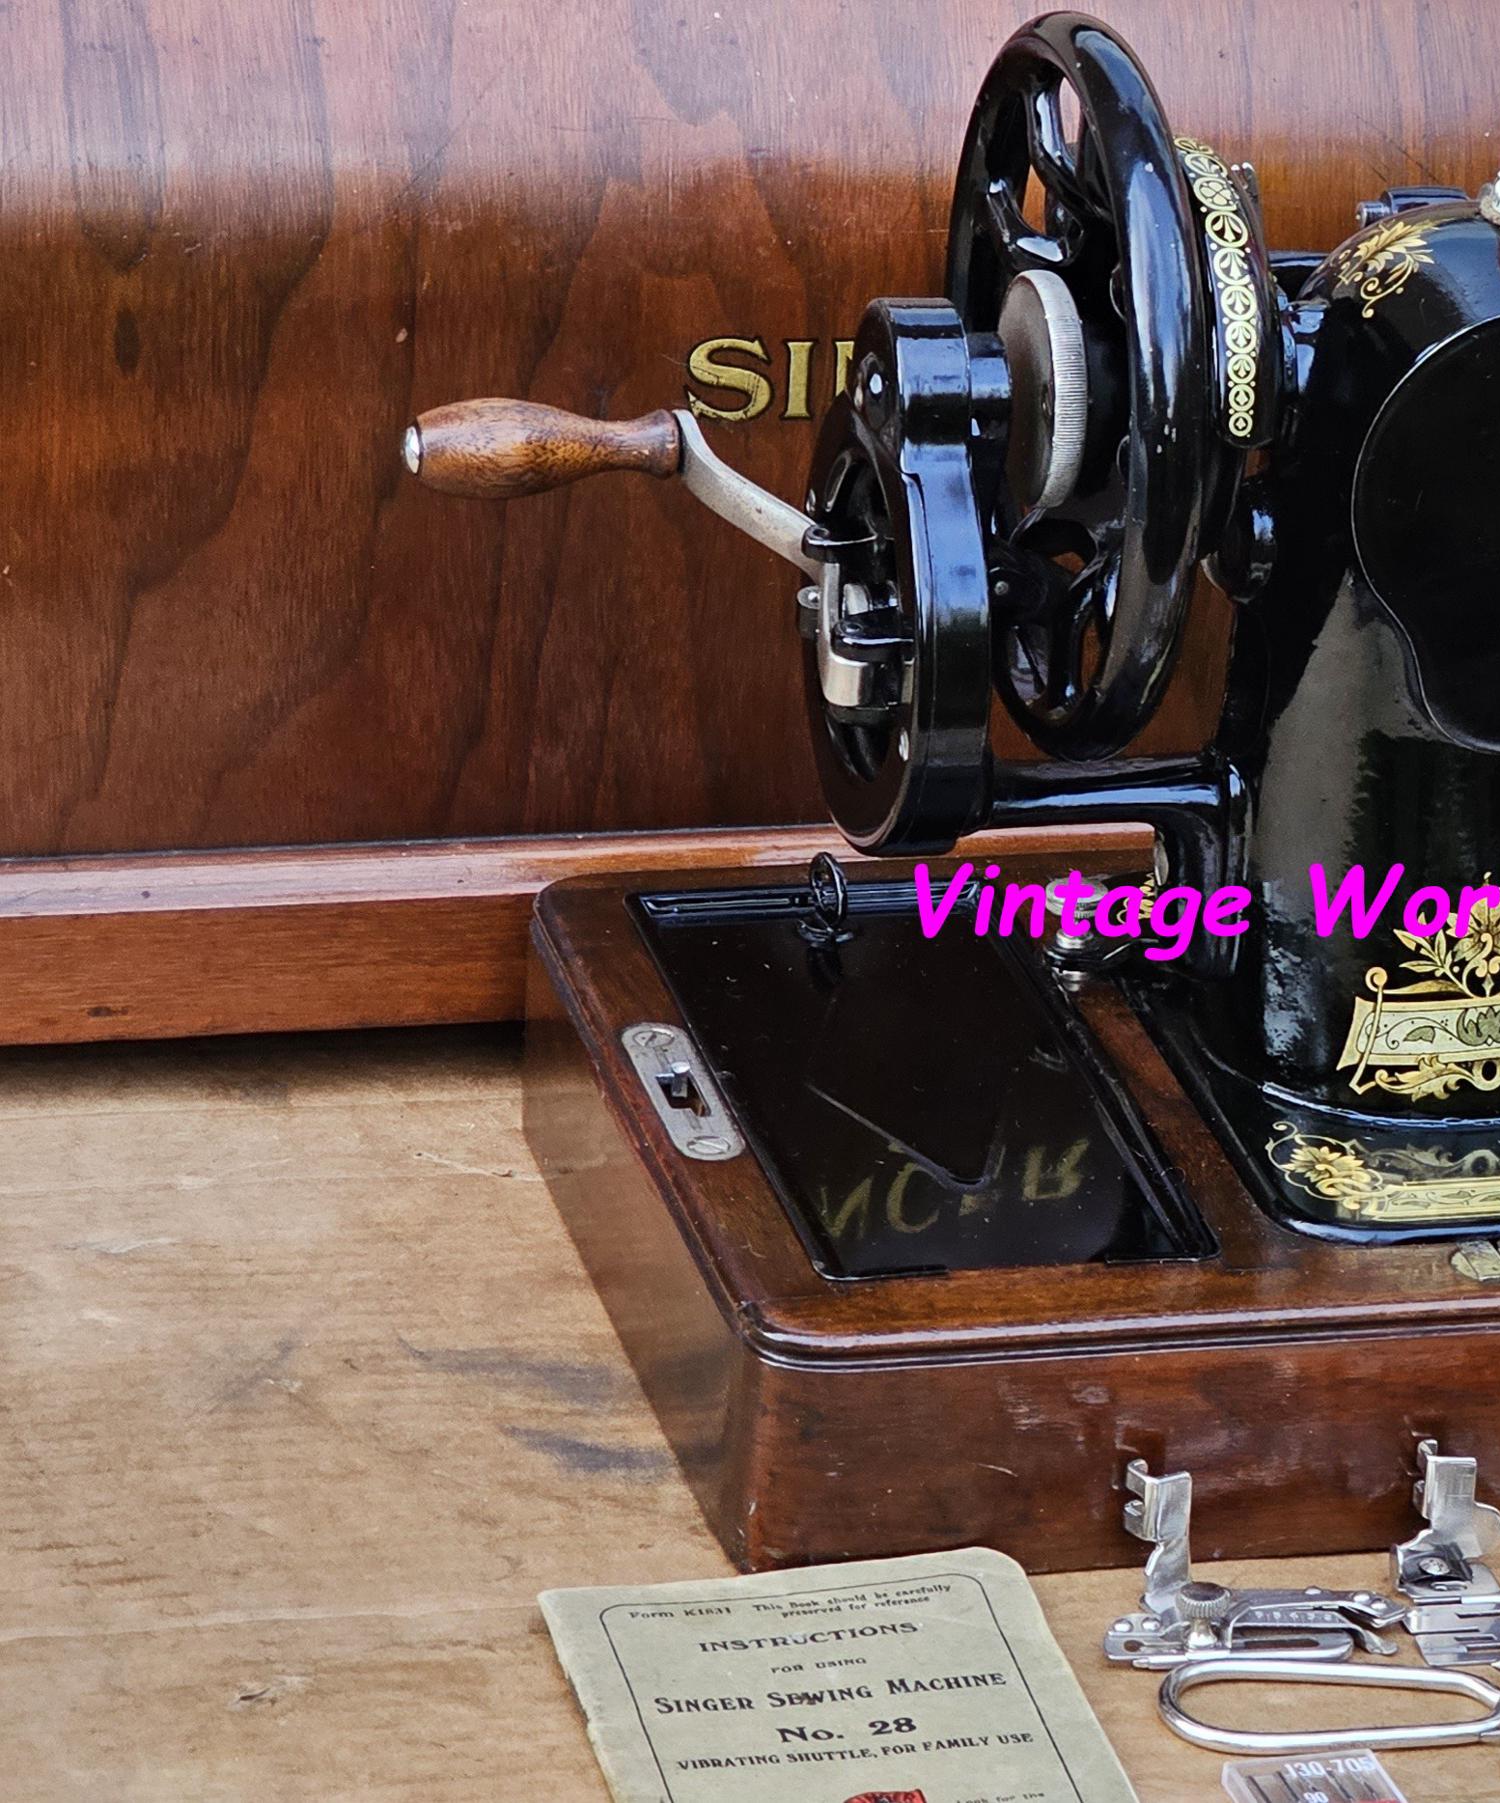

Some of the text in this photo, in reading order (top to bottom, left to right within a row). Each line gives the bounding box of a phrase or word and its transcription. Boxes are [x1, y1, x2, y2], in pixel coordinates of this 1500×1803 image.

[629, 1610, 675, 1619] Form
[753, 1603, 783, 1612] This
[790, 1600, 820, 1610] Book
[849, 1602, 867, 1611] for
[699, 1621, 918, 1653] INSTRUCTIONS
[771, 1656, 868, 1675] FOR USING
[654, 1672, 1007, 1715] SINGER SEWING MACHINE
[776, 1716, 918, 1743] No. 28
[677, 1732, 1034, 1771] VIBRATING SHUTTLE, FOR FAMILY USE
